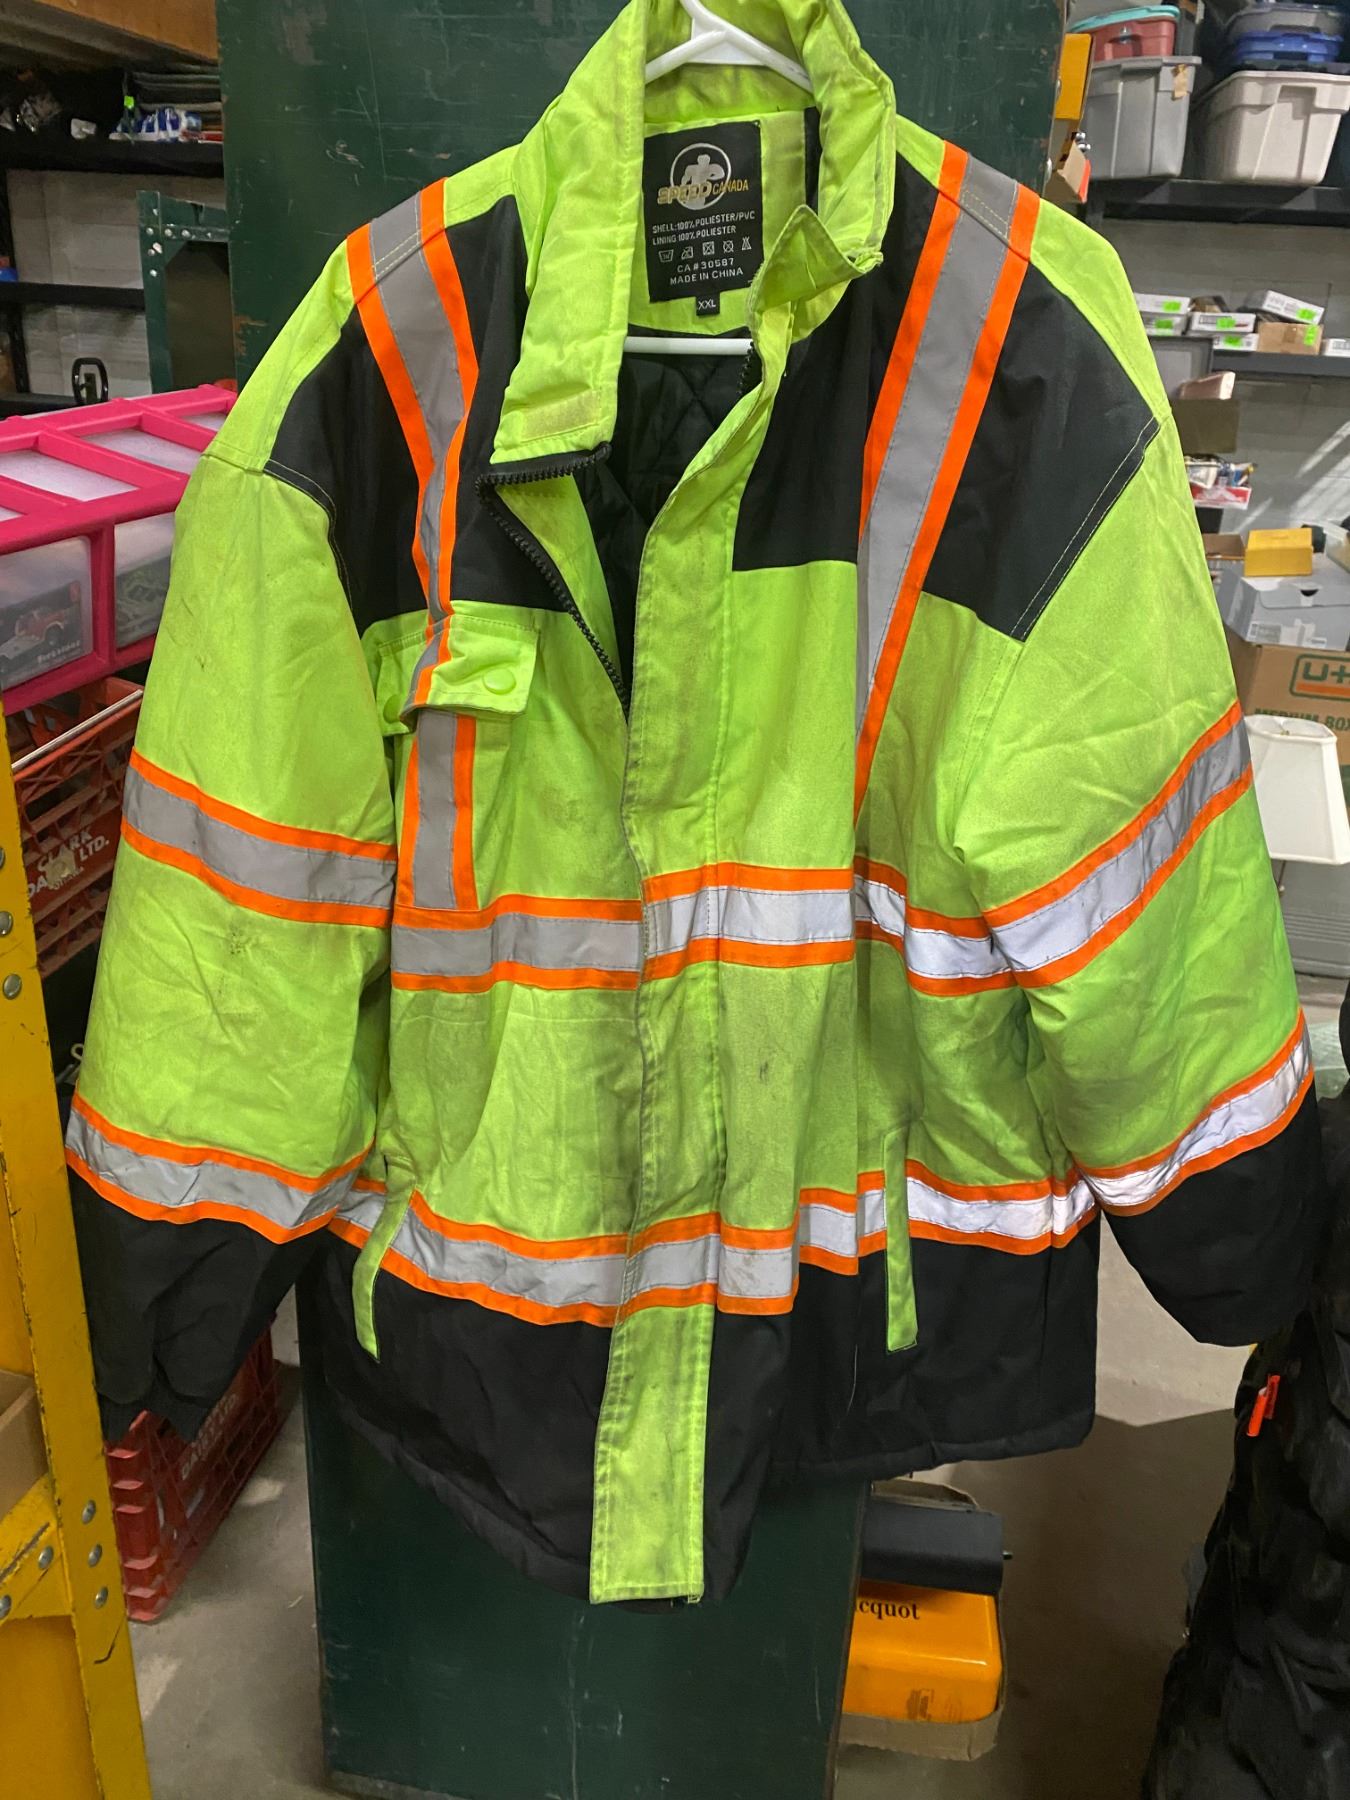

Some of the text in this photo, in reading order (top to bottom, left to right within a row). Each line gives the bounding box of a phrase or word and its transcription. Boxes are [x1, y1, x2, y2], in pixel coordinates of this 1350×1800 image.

[713, 179, 749, 195] CANADA
[670, 267, 744, 285] MADE IN CHINA
[697, 298, 717, 311] XXL
[79, 835, 110, 862] LTD.
[859, 1599, 919, 1620] cquot
